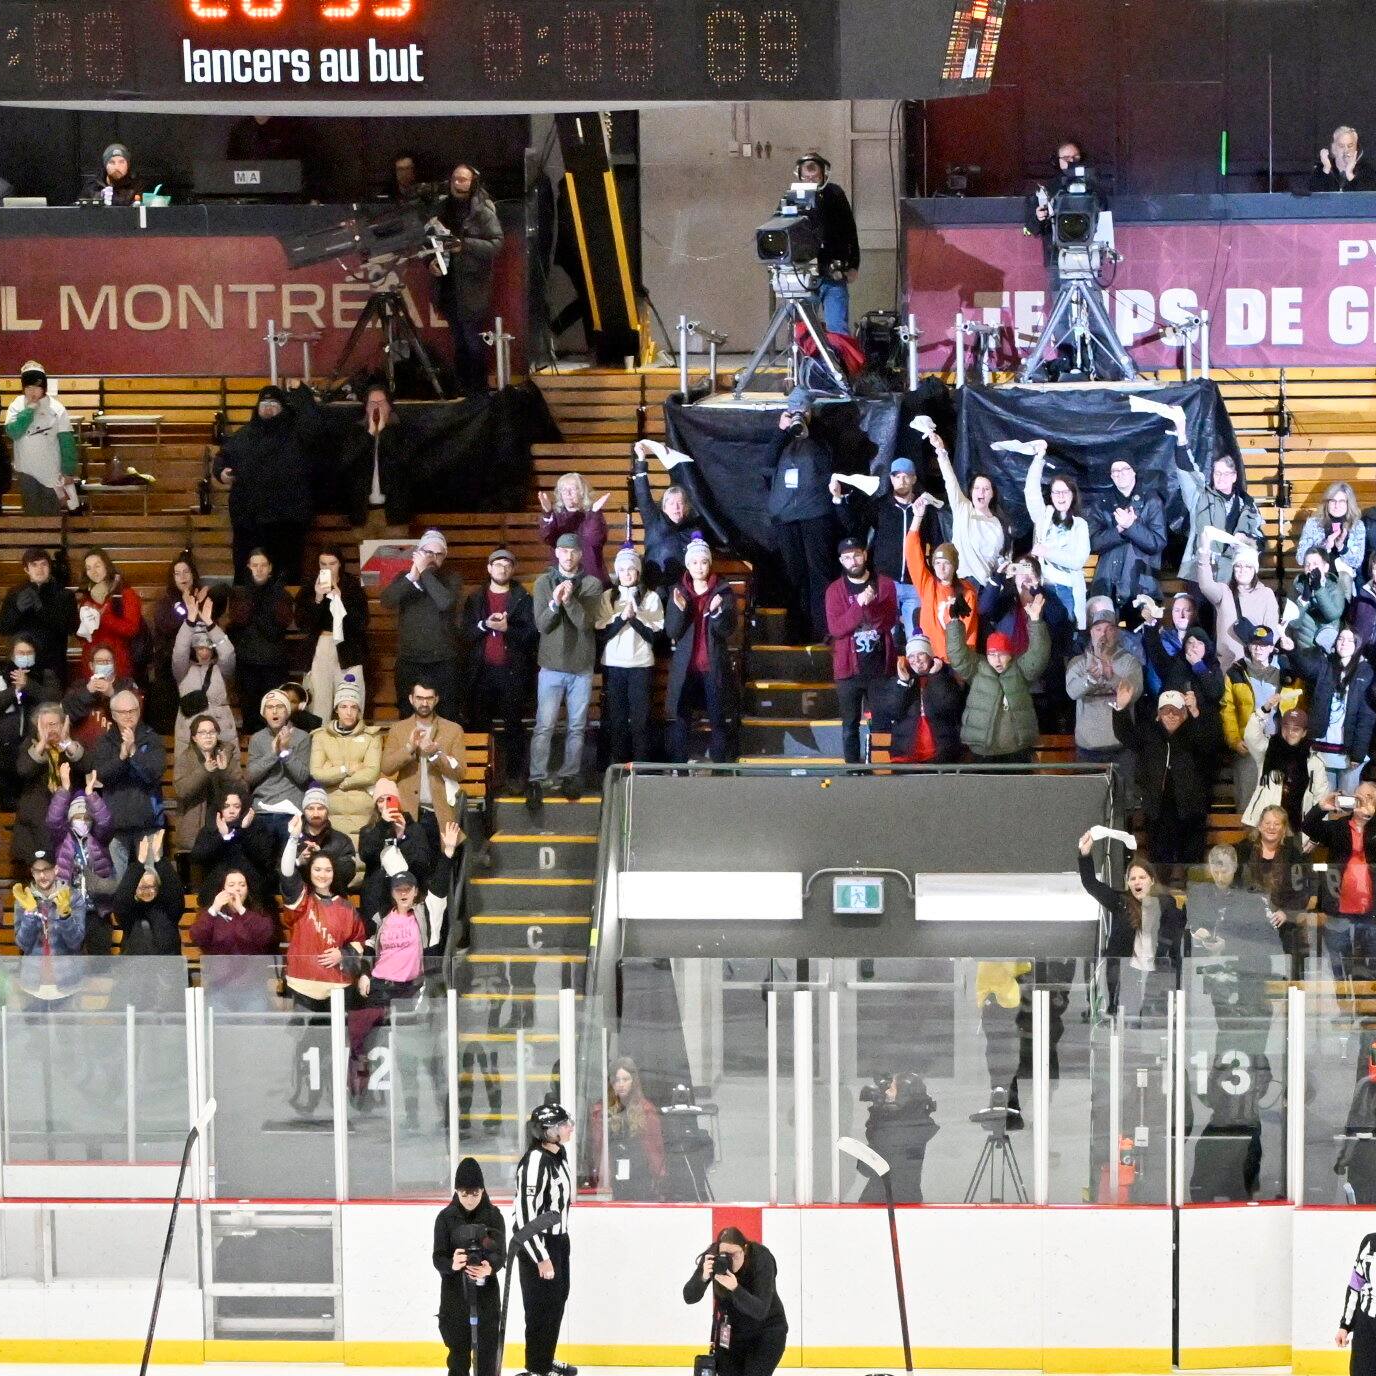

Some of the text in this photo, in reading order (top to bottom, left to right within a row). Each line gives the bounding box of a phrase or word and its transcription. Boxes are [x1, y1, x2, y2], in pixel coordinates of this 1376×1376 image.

[182, 37, 424, 83] lancers au but
[973, 288, 1201, 348] TEPS
[1224, 286, 1303, 346] DE
[539, 846, 556, 871] D
[526, 925, 544, 950] C
